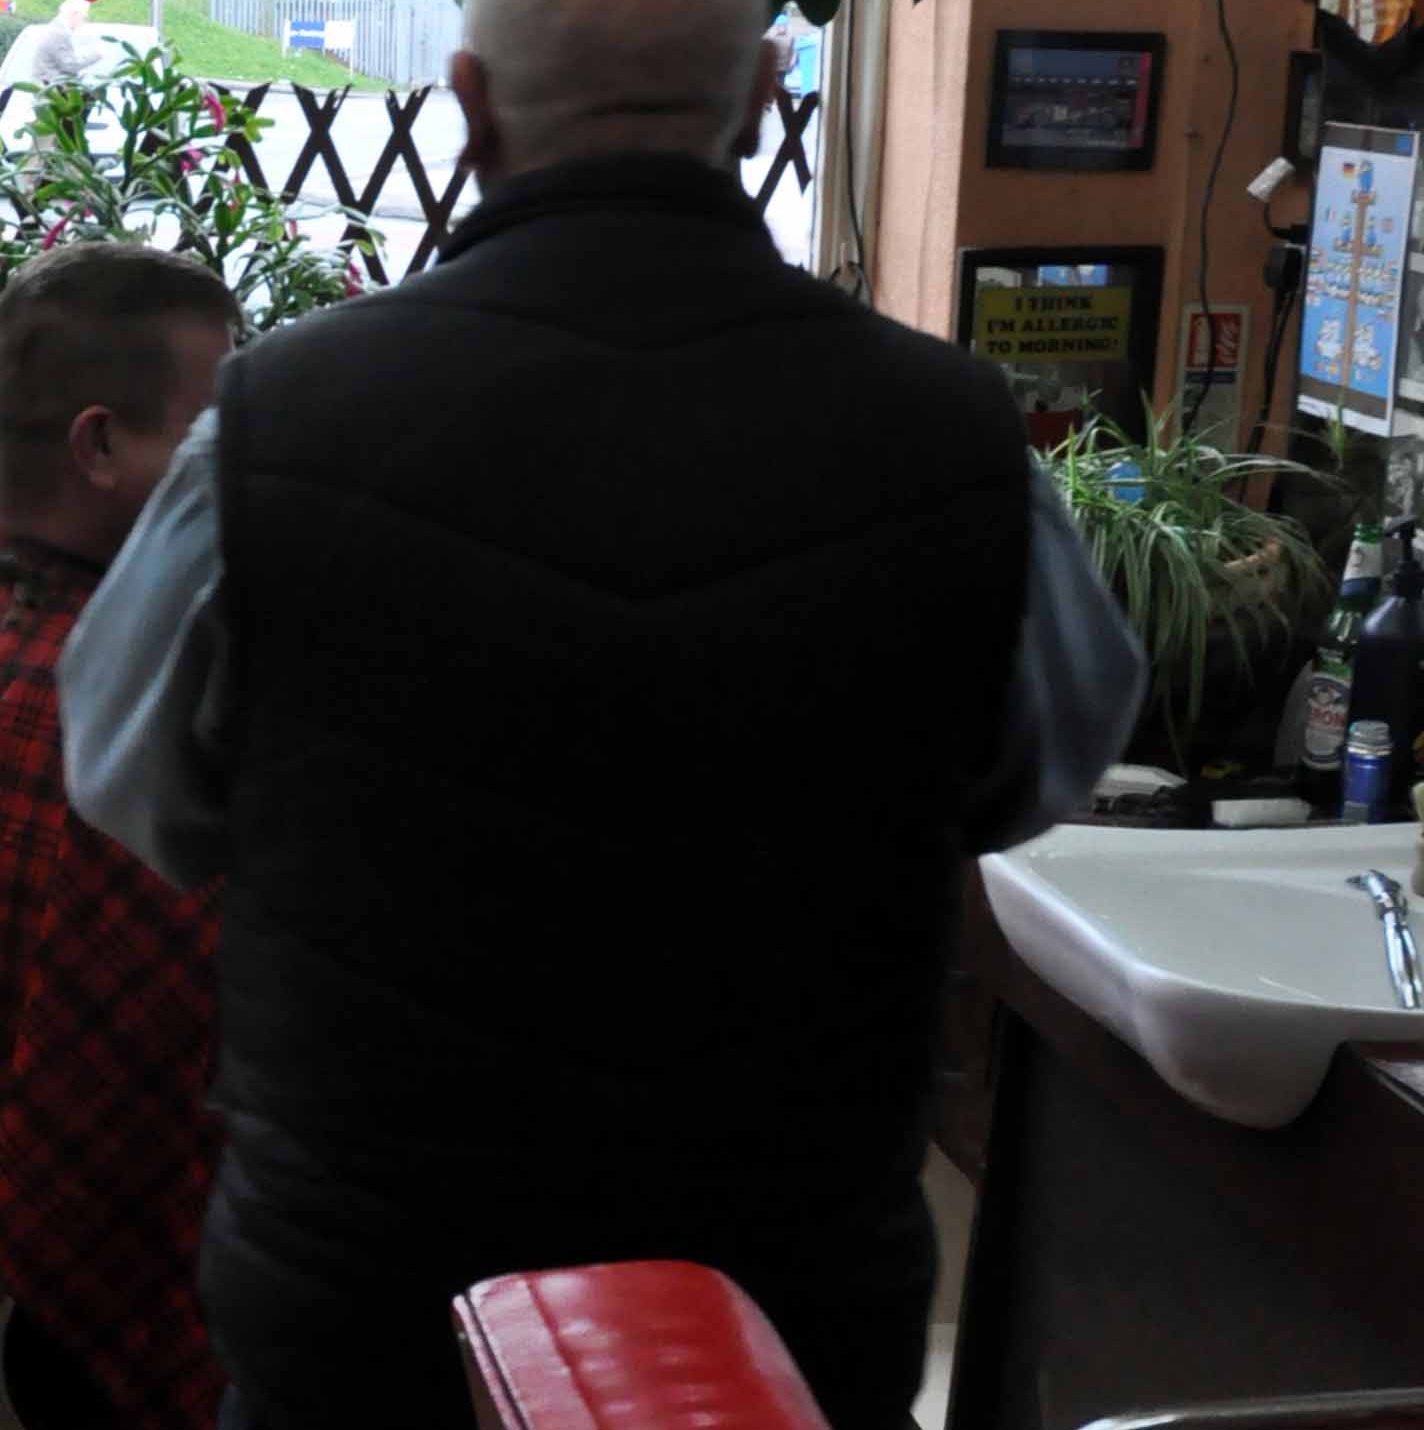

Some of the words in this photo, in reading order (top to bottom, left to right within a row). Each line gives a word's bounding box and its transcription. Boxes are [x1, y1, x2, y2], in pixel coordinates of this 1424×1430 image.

[1028, 296, 1093, 312] THINK
[987, 317, 1015, 332] I'M
[1022, 316, 1119, 332] ALLERGIC
[987, 339, 1011, 354] TO
